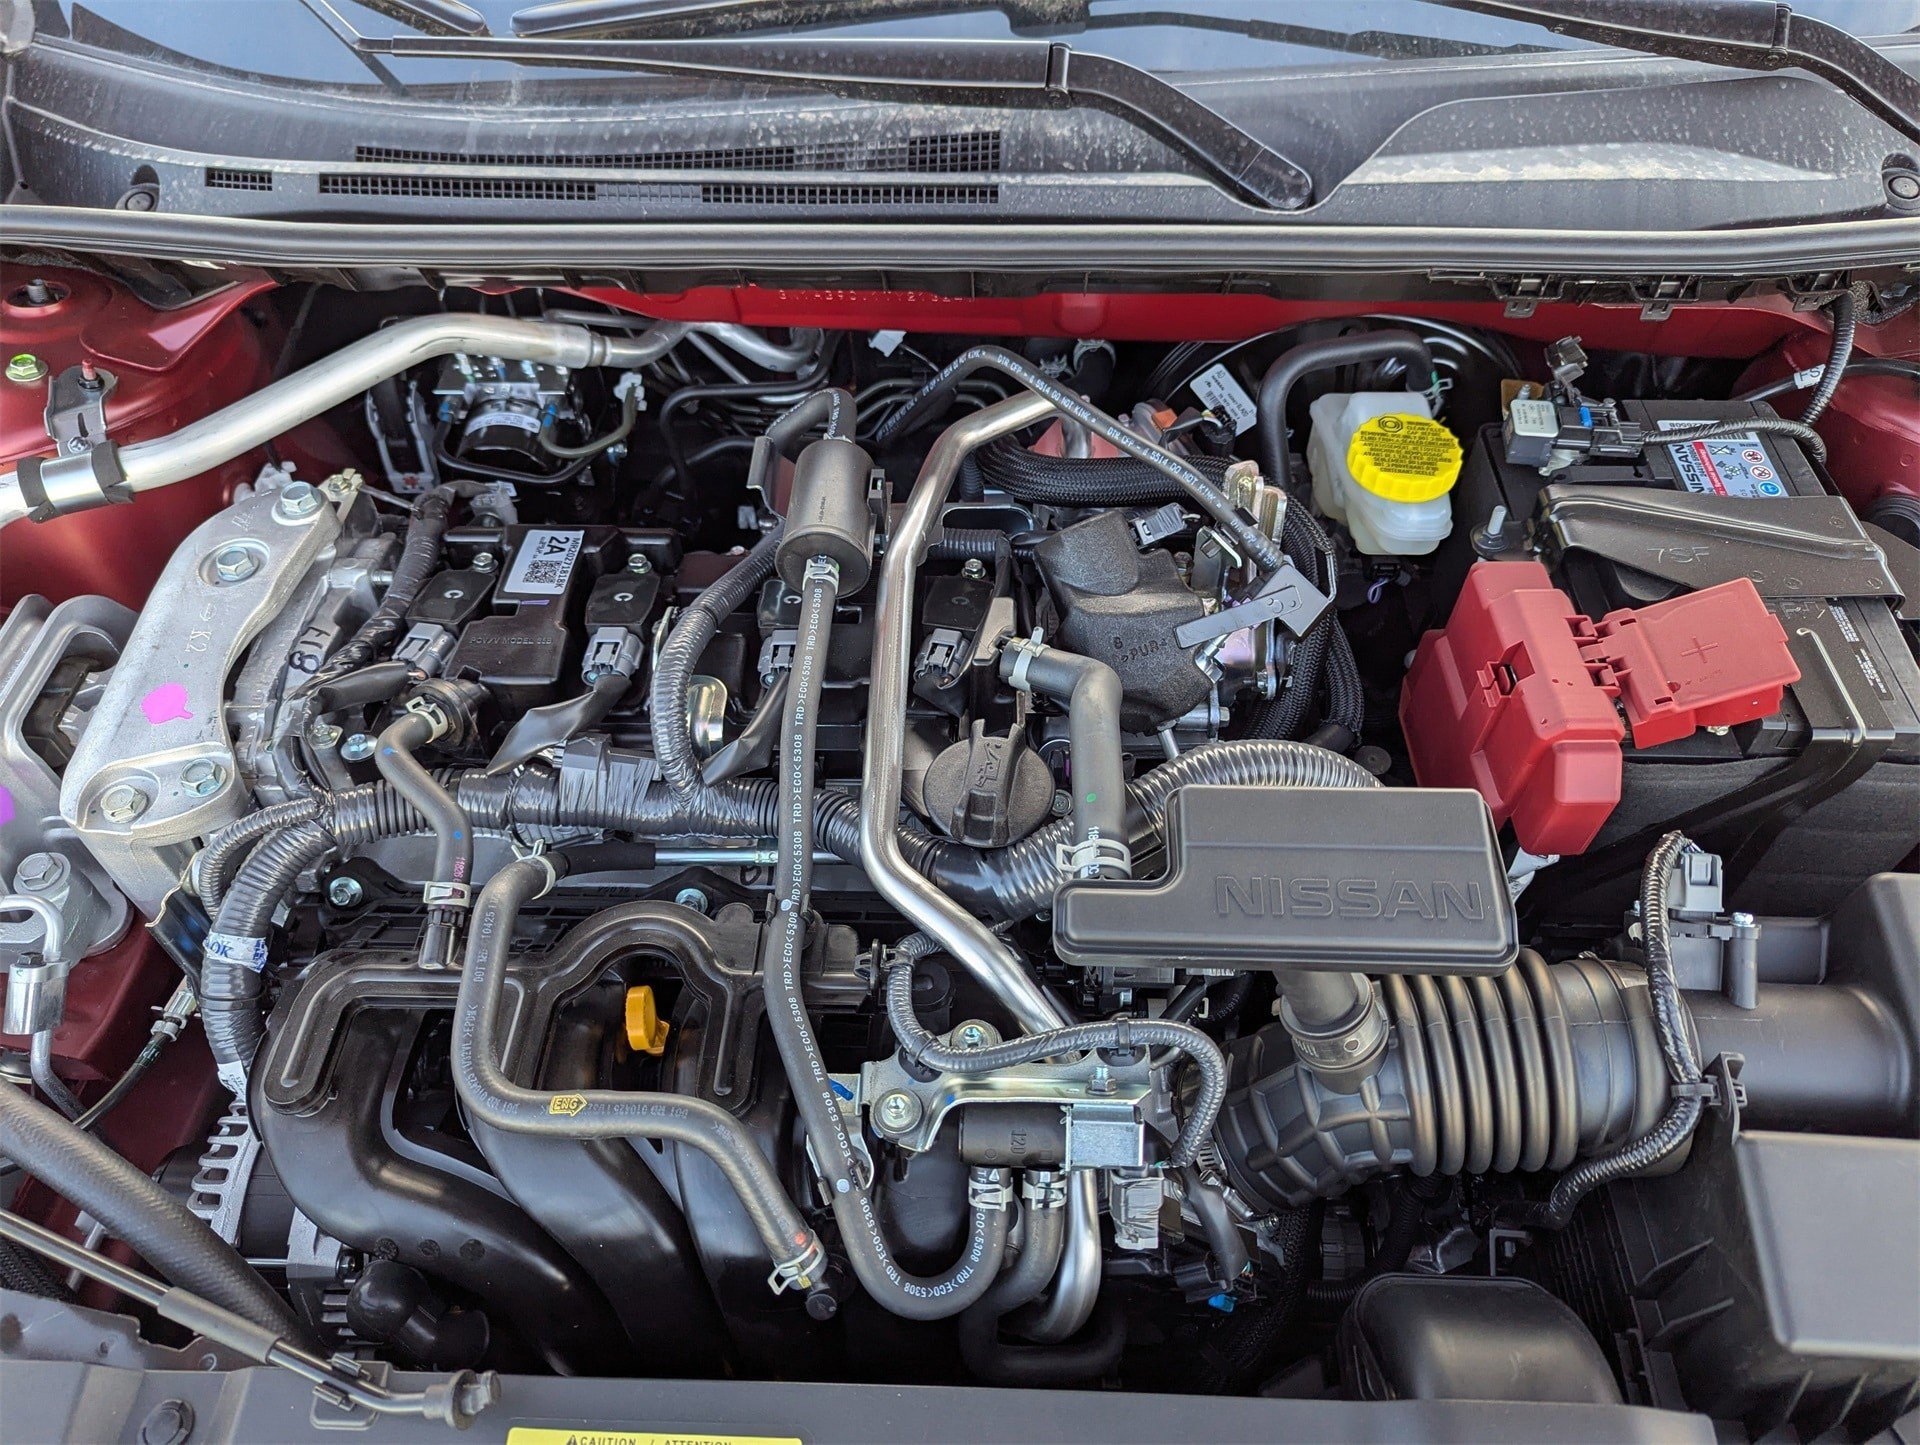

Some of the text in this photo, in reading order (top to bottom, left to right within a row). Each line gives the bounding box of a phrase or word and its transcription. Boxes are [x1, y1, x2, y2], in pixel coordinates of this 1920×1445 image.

[1182, 470, 1199, 486] NOT
[542, 536, 570, 556] 2A
[806, 588, 823, 651] TRD>ECO<5308
[794, 655, 813, 726] TRD>ECO<5308
[793, 734, 803, 823] TRD>ECO<5308
[1214, 875, 1485, 920] NISSAN
[554, 1096, 579, 1110] ENG
[580, 1436, 636, 1445] CAUTION
